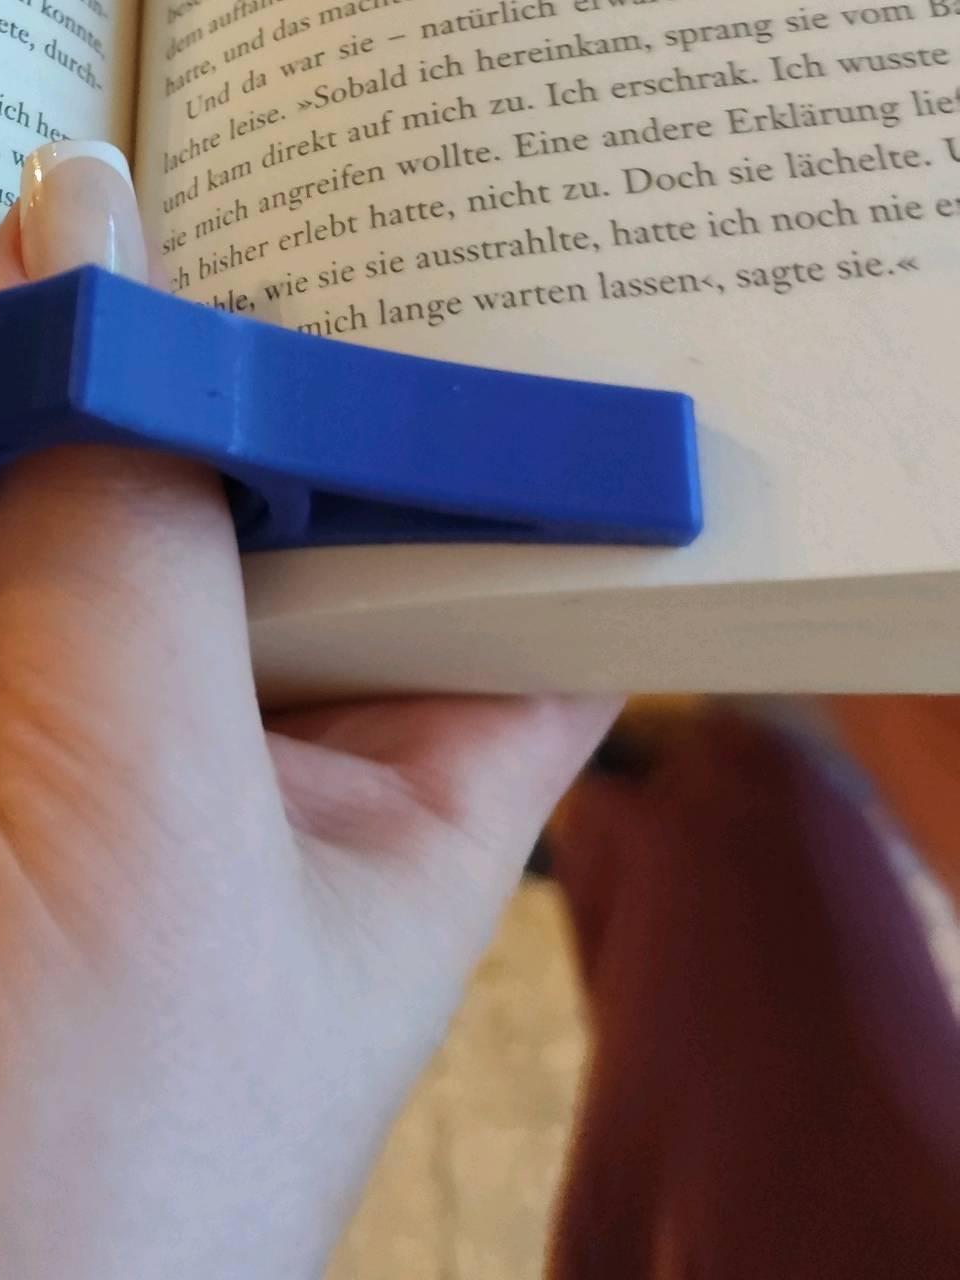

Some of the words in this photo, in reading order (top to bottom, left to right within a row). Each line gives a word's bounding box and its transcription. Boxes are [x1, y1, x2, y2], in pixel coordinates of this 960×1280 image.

[162, 132, 221, 175] lachte
[228, 108, 286, 141] leise.
[418, 53, 465, 83] ich
[475, 33, 654, 72] hereinkam,
[663, 19, 774, 53] sprang
[783, 7, 830, 33] sie
[839, 4, 916, 26] vom
[184, 80, 230, 120] Und
[240, 69, 268, 95] da
[278, 51, 326, 78] war
[337, 34, 374, 60] sie
[222, 26, 265, 64] und
[270, 16, 312, 42] das
[158, 228, 188, 256] sie
[193, 198, 249, 239] mich
[257, 163, 385, 213] angreifen
[395, 142, 501, 176] wollte.
[513, 130, 589, 159] Eine
[601, 116, 714, 148] andere
[726, 101, 901, 135] Erklärung
[161, 175, 199, 218] und
[205, 160, 252, 192] kam
[260, 129, 337, 169] direkt
[346, 109, 392, 143] auf
[401, 96, 477, 131] mich
[487, 95, 535, 116] zu.
[546, 78, 600, 108] Ich
[609, 60, 759, 99] erschrak.
[770, 52, 828, 82] Ich
[836, 48, 950, 74] wusste
[197, 241, 269, 280] bisher
[277, 213, 358, 251] erlebt
[368, 200, 456, 230] hatte,
[466, 180, 551, 213] nicht
[561, 181, 610, 201] zu.
[623, 161, 718, 195] Doch
[727, 156, 774, 185] sie
[785, 143, 932, 179] lächelte.
[262, 272, 309, 302] wie
[316, 260, 355, 289] sie
[364, 250, 405, 279] sie
[415, 226, 600, 269] ausstrahlte,
[609, 219, 697, 247] hatte
[706, 207, 762, 238] ich
[770, 198, 859, 232] noch
[867, 194, 925, 224] nie
[377, 297, 462, 328] lange
[472, 283, 588, 311] warten
[734, 262, 825, 295] sagte
